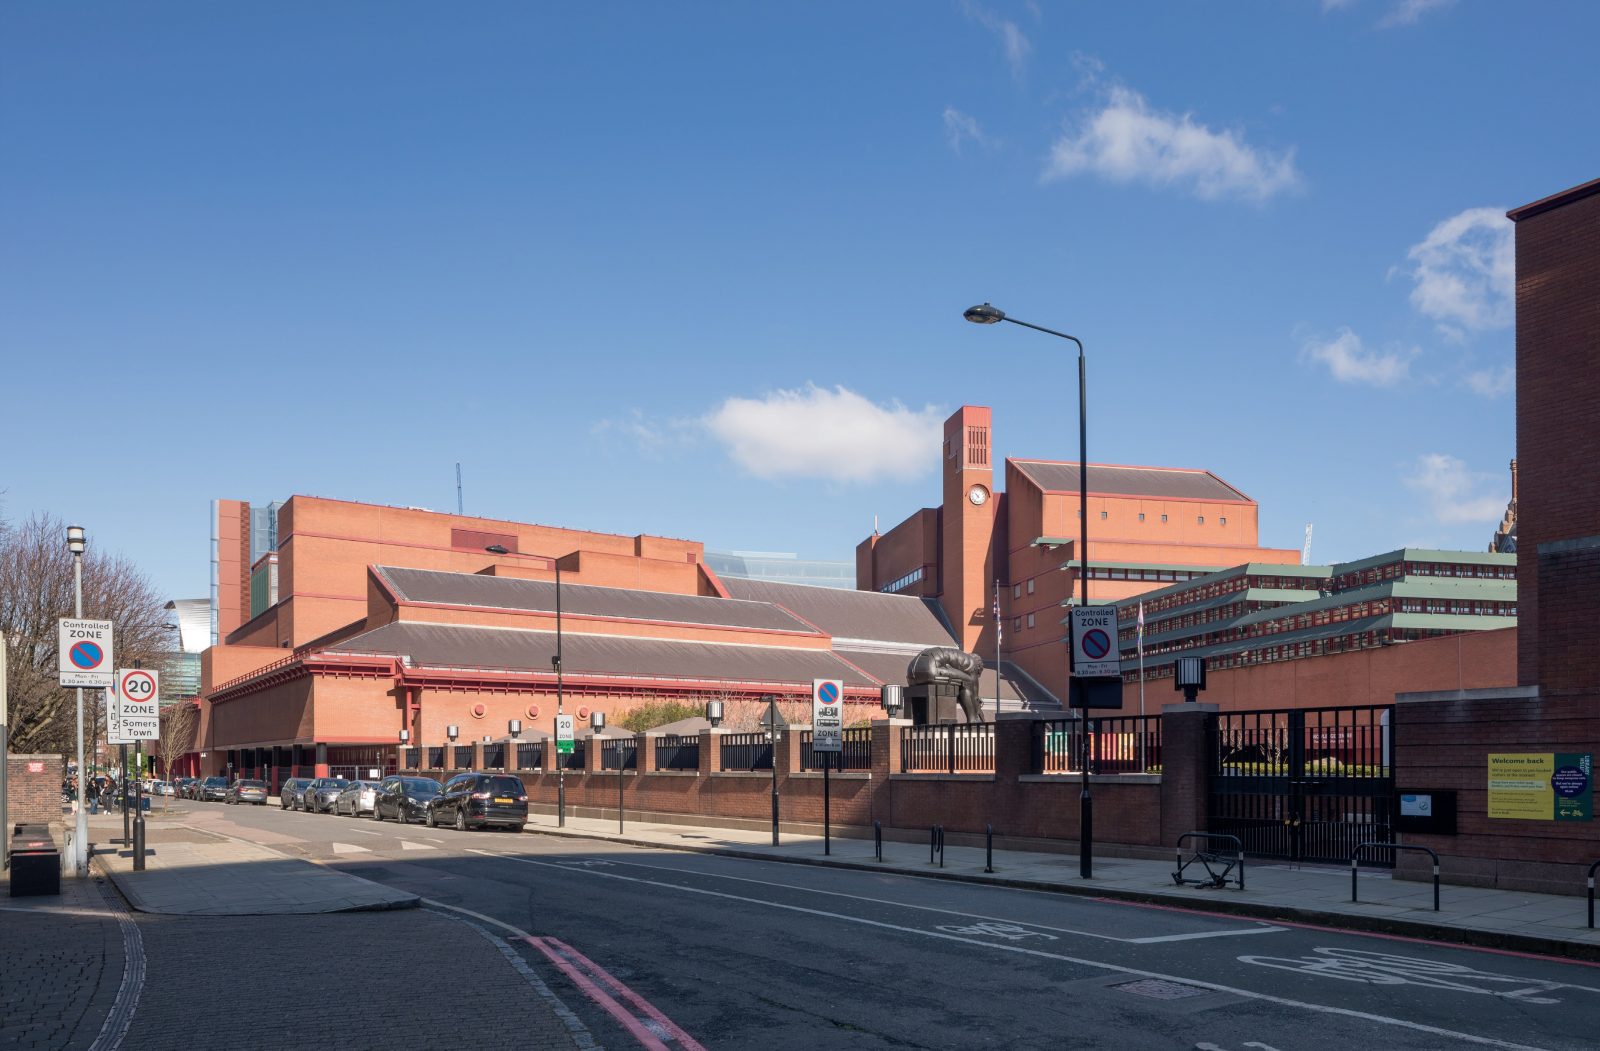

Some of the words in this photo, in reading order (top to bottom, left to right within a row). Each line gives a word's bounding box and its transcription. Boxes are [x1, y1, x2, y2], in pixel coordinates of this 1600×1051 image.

[1075, 609, 1114, 617] Controlled
[62, 621, 110, 630] Controlled
[1081, 618, 1109, 627] ZONE
[70, 630, 102, 638] ZONE
[128, 680, 152, 694] 20
[123, 705, 155, 714] ZONE
